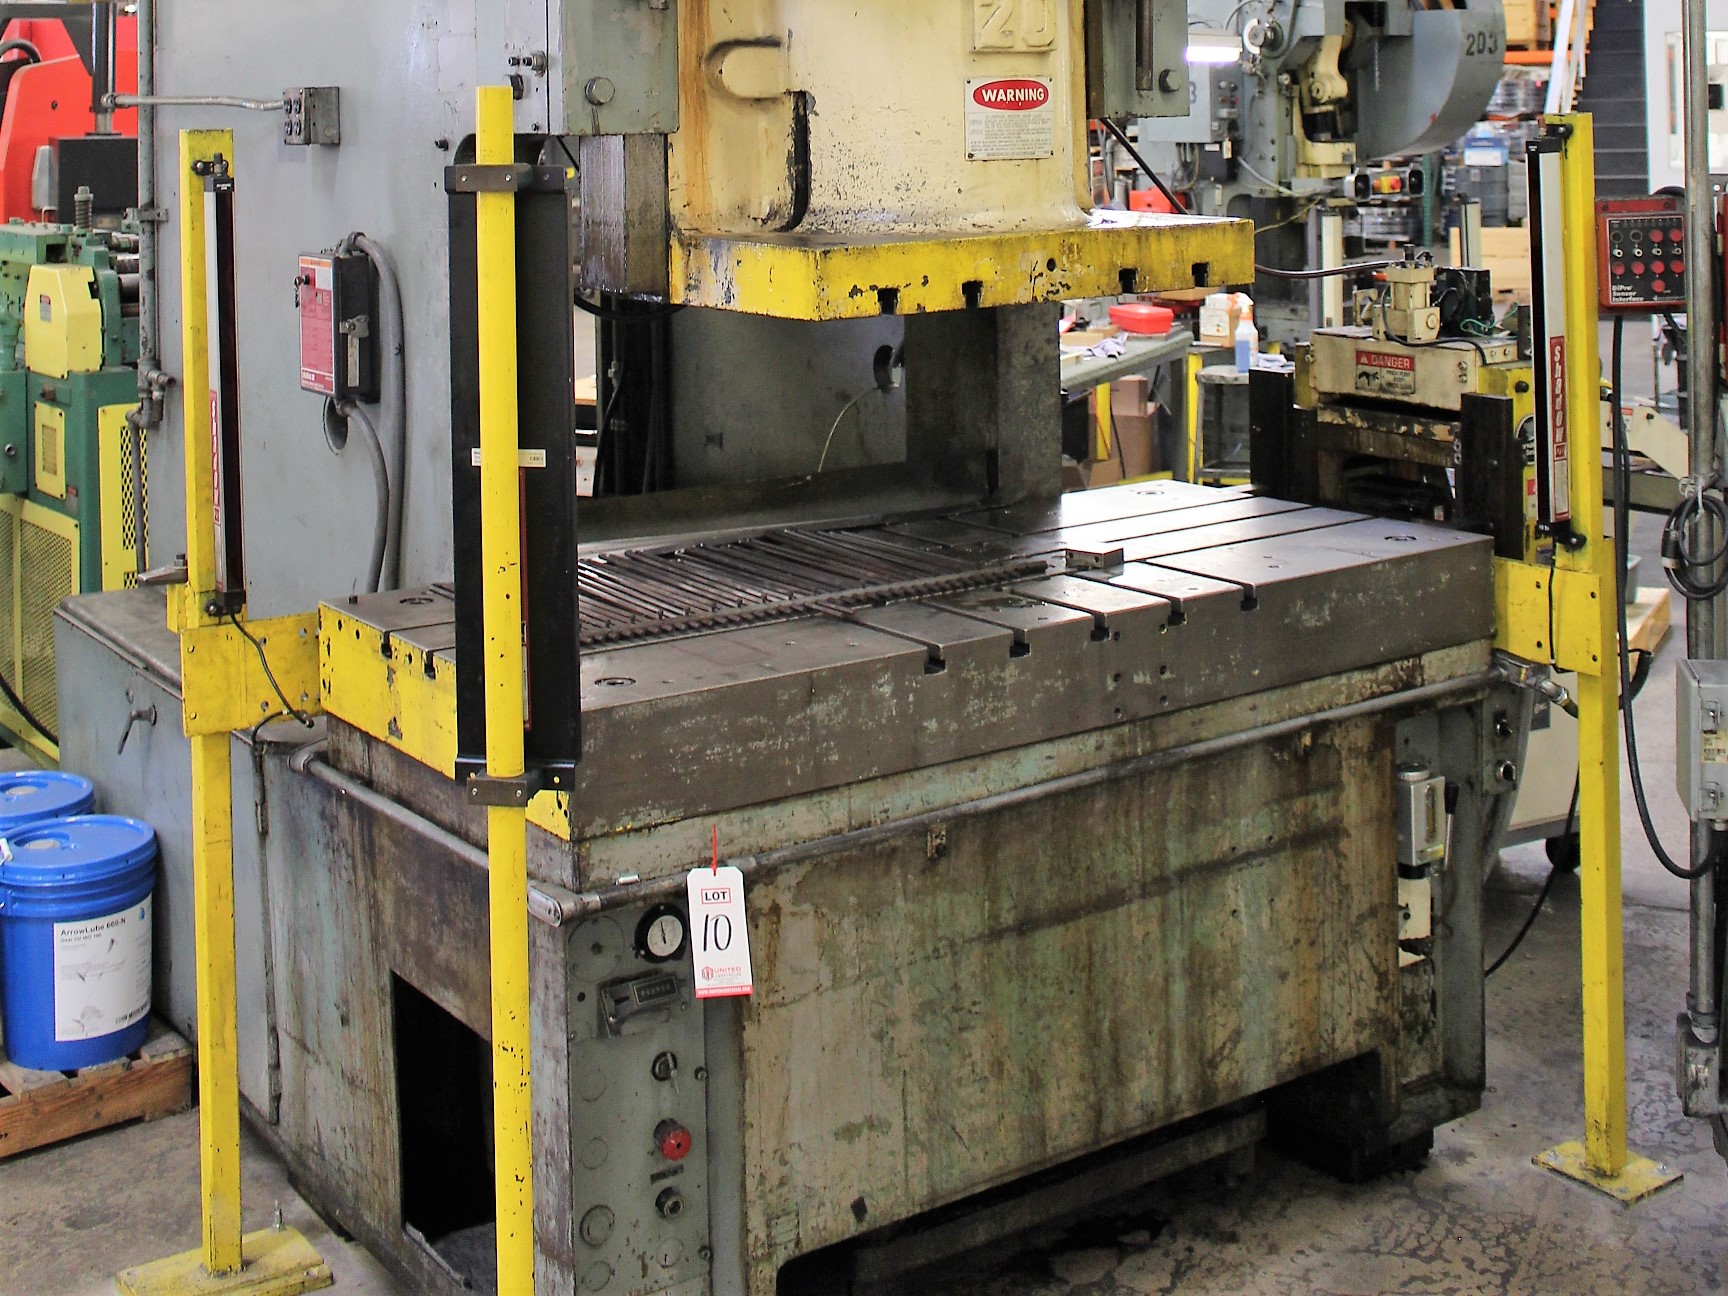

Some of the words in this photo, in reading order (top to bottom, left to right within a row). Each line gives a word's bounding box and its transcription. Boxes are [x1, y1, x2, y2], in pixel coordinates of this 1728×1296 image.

[1465, 31, 1499, 56] 203
[981, 87, 1045, 102] WARNING
[1371, 354, 1410, 369] DANGER
[705, 891, 728, 901] LOT
[61, 925, 104, 936] ArrowLube
[703, 914, 732, 952] 10
